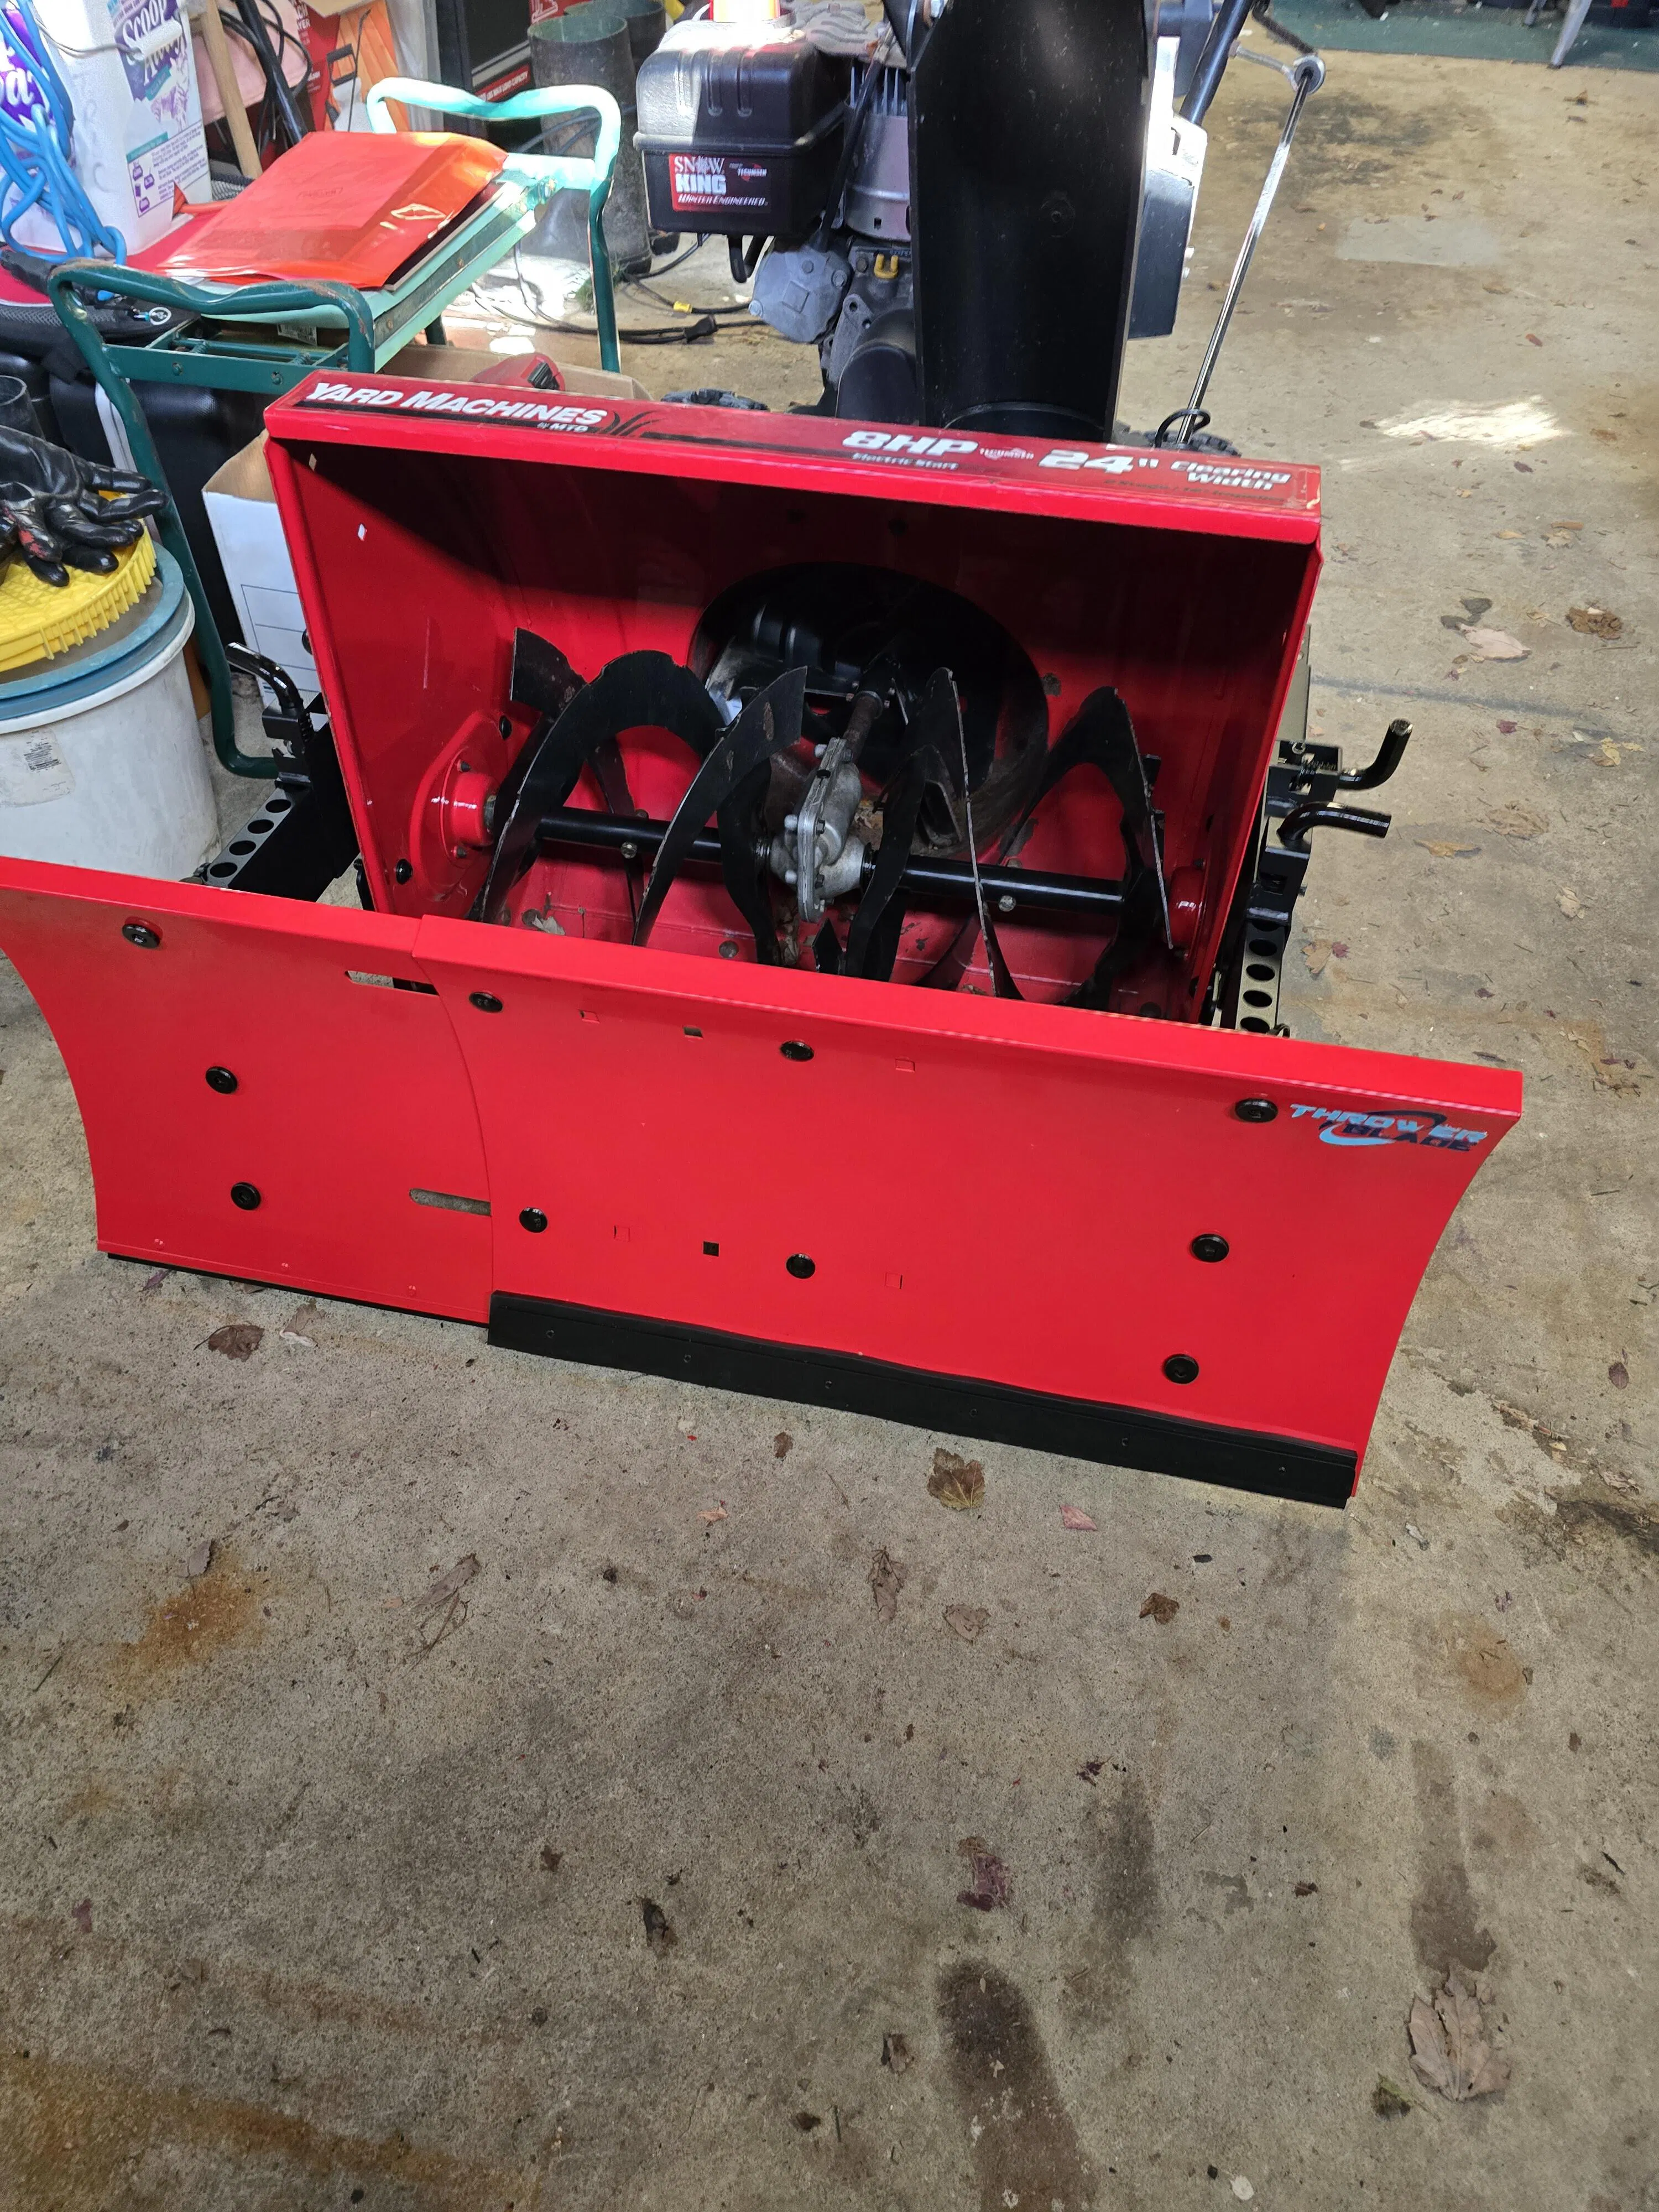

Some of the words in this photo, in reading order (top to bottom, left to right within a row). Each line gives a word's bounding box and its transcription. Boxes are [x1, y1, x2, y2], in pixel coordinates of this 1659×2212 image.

[675, 174, 727, 195] KING
[305, 383, 404, 406] YARD
[399, 390, 608, 426] MACHINES
[549, 423, 589, 433] MTD
[842, 430, 979, 456] 8HP
[1170, 460, 1291, 484] Clearing
[1187, 472, 1272, 491] Width
[1290, 1104, 1488, 1143] THROWER
